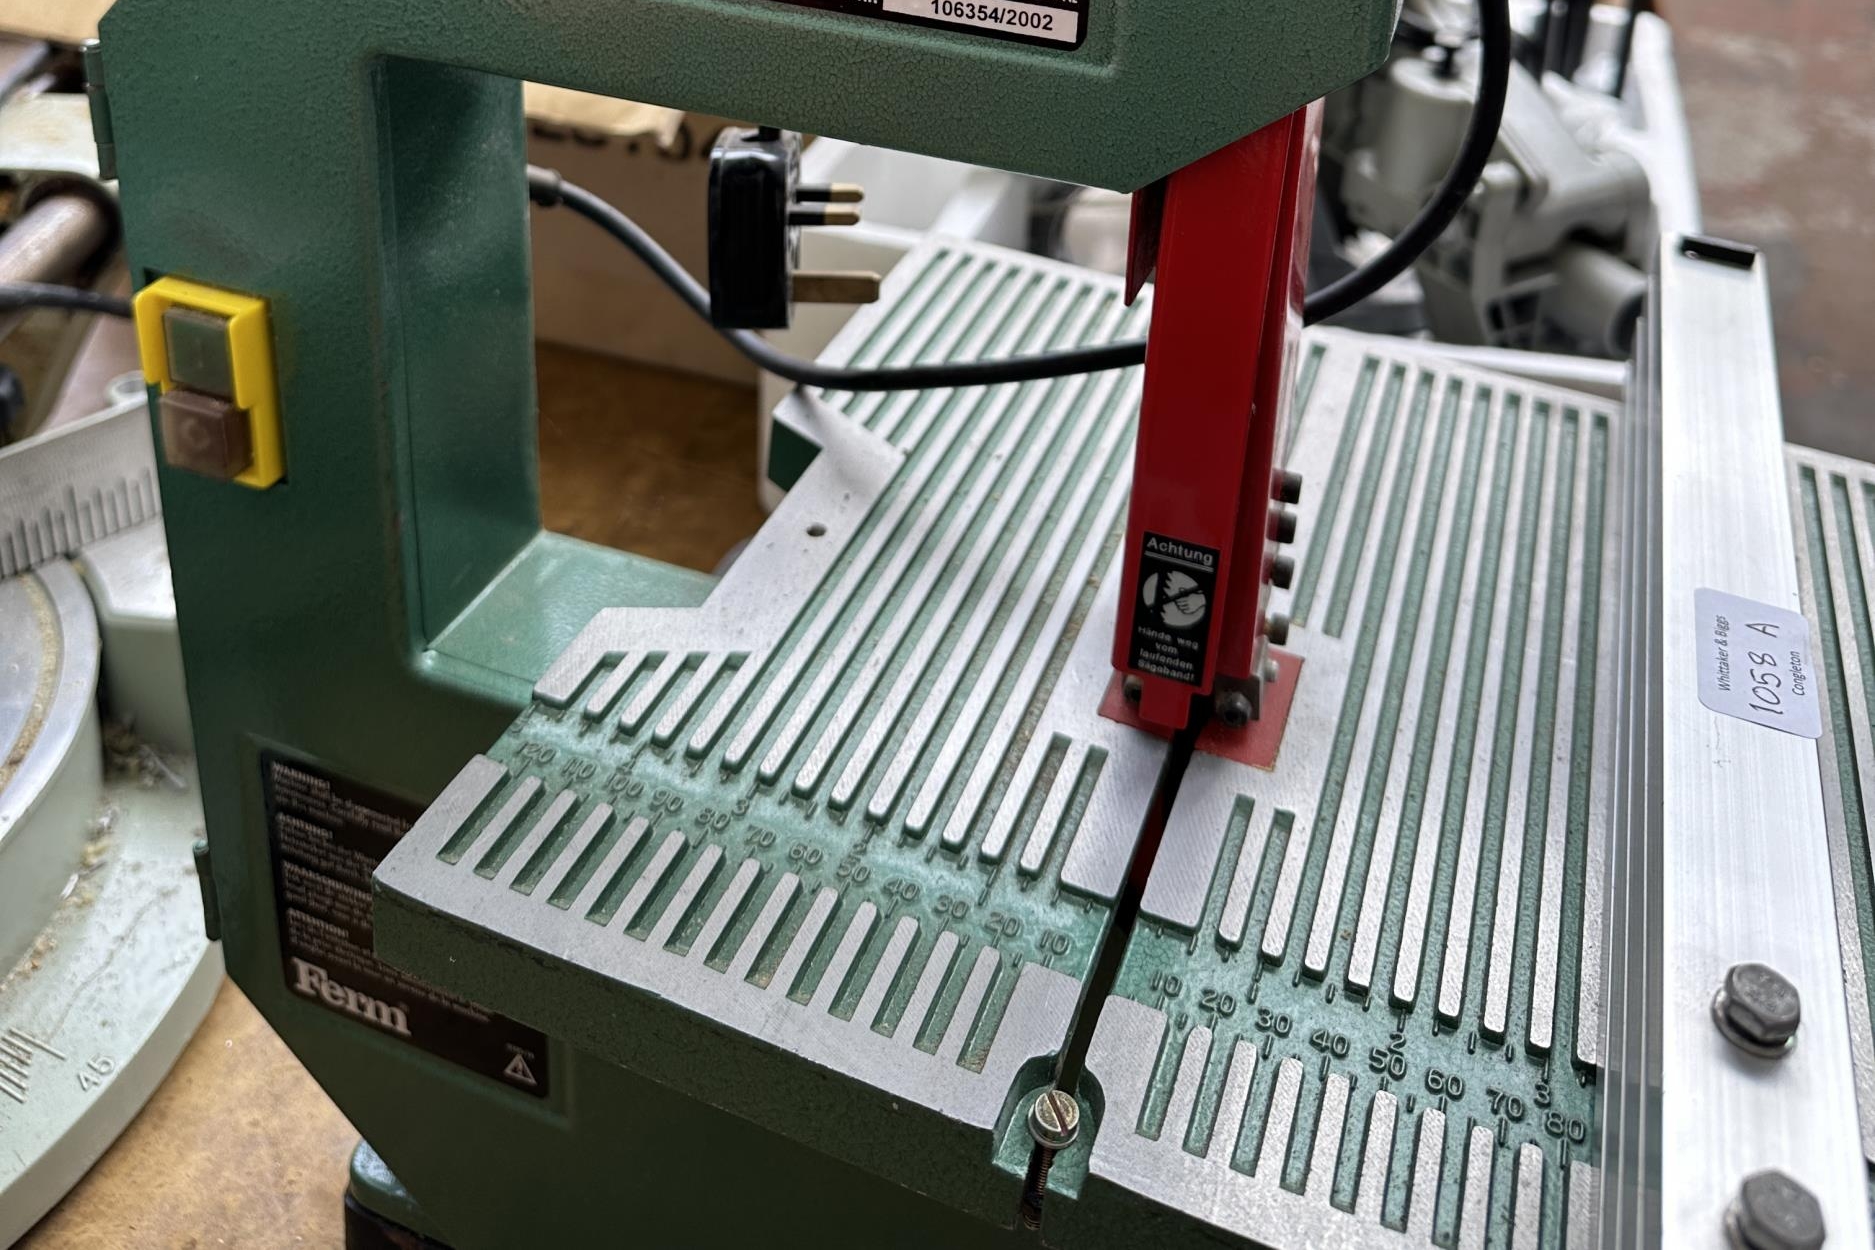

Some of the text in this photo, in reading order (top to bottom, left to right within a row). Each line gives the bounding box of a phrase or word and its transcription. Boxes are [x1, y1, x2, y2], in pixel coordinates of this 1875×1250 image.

[1147, 537, 1213, 565] Achtung
[1155, 642, 1178, 654] vom
[1714, 615, 1731, 691] Whittaker & Biggs
[1745, 622, 1784, 715] 1058 A
[1788, 651, 1806, 695] Congleton
[561, 756, 598, 781] 110
[606, 772, 645, 798] 100
[651, 788, 684, 813] 90
[696, 808, 731, 831] 80
[746, 825, 777, 848] 70
[789, 840, 823, 865] 60
[884, 878, 921, 901] 40
[933, 895, 970, 920] 30
[984, 911, 1023, 937] 20
[1038, 929, 1071, 956] 10
[291, 956, 411, 1037] Ferm
[77, 1054, 116, 1091] 45
[1152, 970, 1585, 1143] 10 20 30 40 50 60 70 80
[1390, 1032, 1407, 1052] 2
[1535, 1082, 1550, 1106] 3
